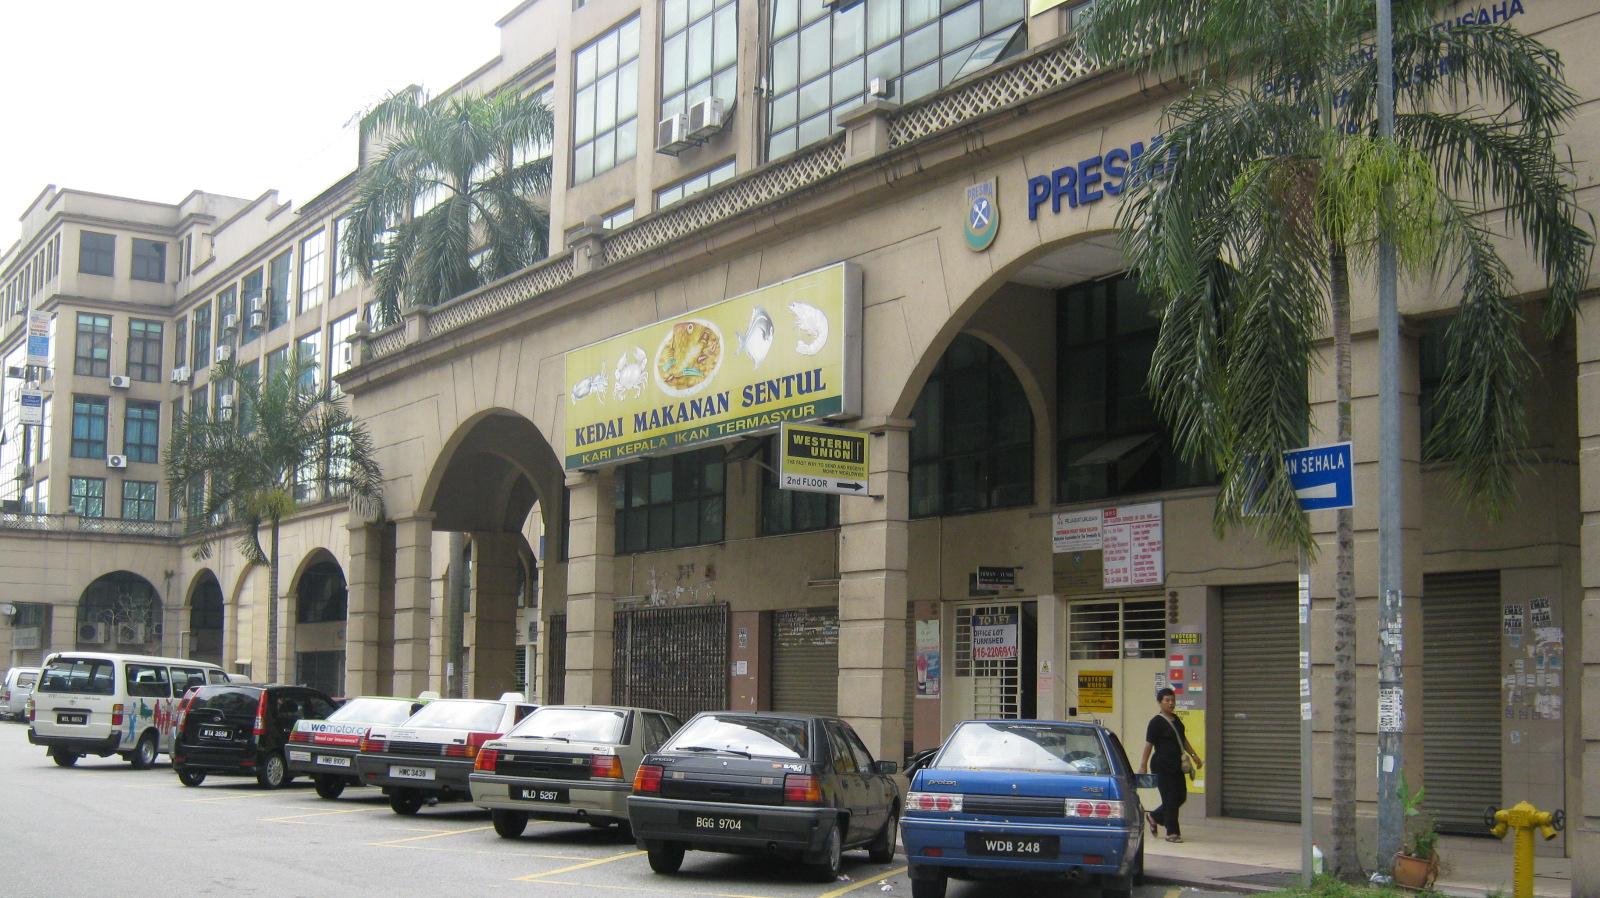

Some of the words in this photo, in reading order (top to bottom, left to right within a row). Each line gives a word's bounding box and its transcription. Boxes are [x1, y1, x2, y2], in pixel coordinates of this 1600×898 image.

[1028, 134, 1179, 221] PRESM
[967, 182, 993, 200] PRESMA
[575, 417, 624, 447] KEDAI
[633, 391, 729, 433] MAKANAN
[742, 368, 826, 407] SENTUL
[582, 450, 611, 465] KARI
[617, 437, 668, 456] KEPALA
[675, 427, 709, 444] IKAN
[718, 404, 815, 434] TERMASYUR
[793, 434, 850, 450] WESTERN
[811, 447, 850, 460] UNION
[1301, 452, 1345, 474] SEHALA
[787, 476, 801, 486] 2nd
[802, 477, 828, 488] FLOOR
[1504, 607, 1523, 616] EMAS
[978, 616, 991, 625] TO
[993, 615, 1010, 625] LET
[974, 629, 992, 637] OFFICE
[927, 779, 957, 787] proton
[522, 789, 536, 799] WLD
[540, 791, 558, 801] 5267
[696, 816, 714, 829] BGG
[719, 819, 742, 831] 9704
[985, 840, 1013, 852] WDB
[1017, 841, 1040, 854] 248
